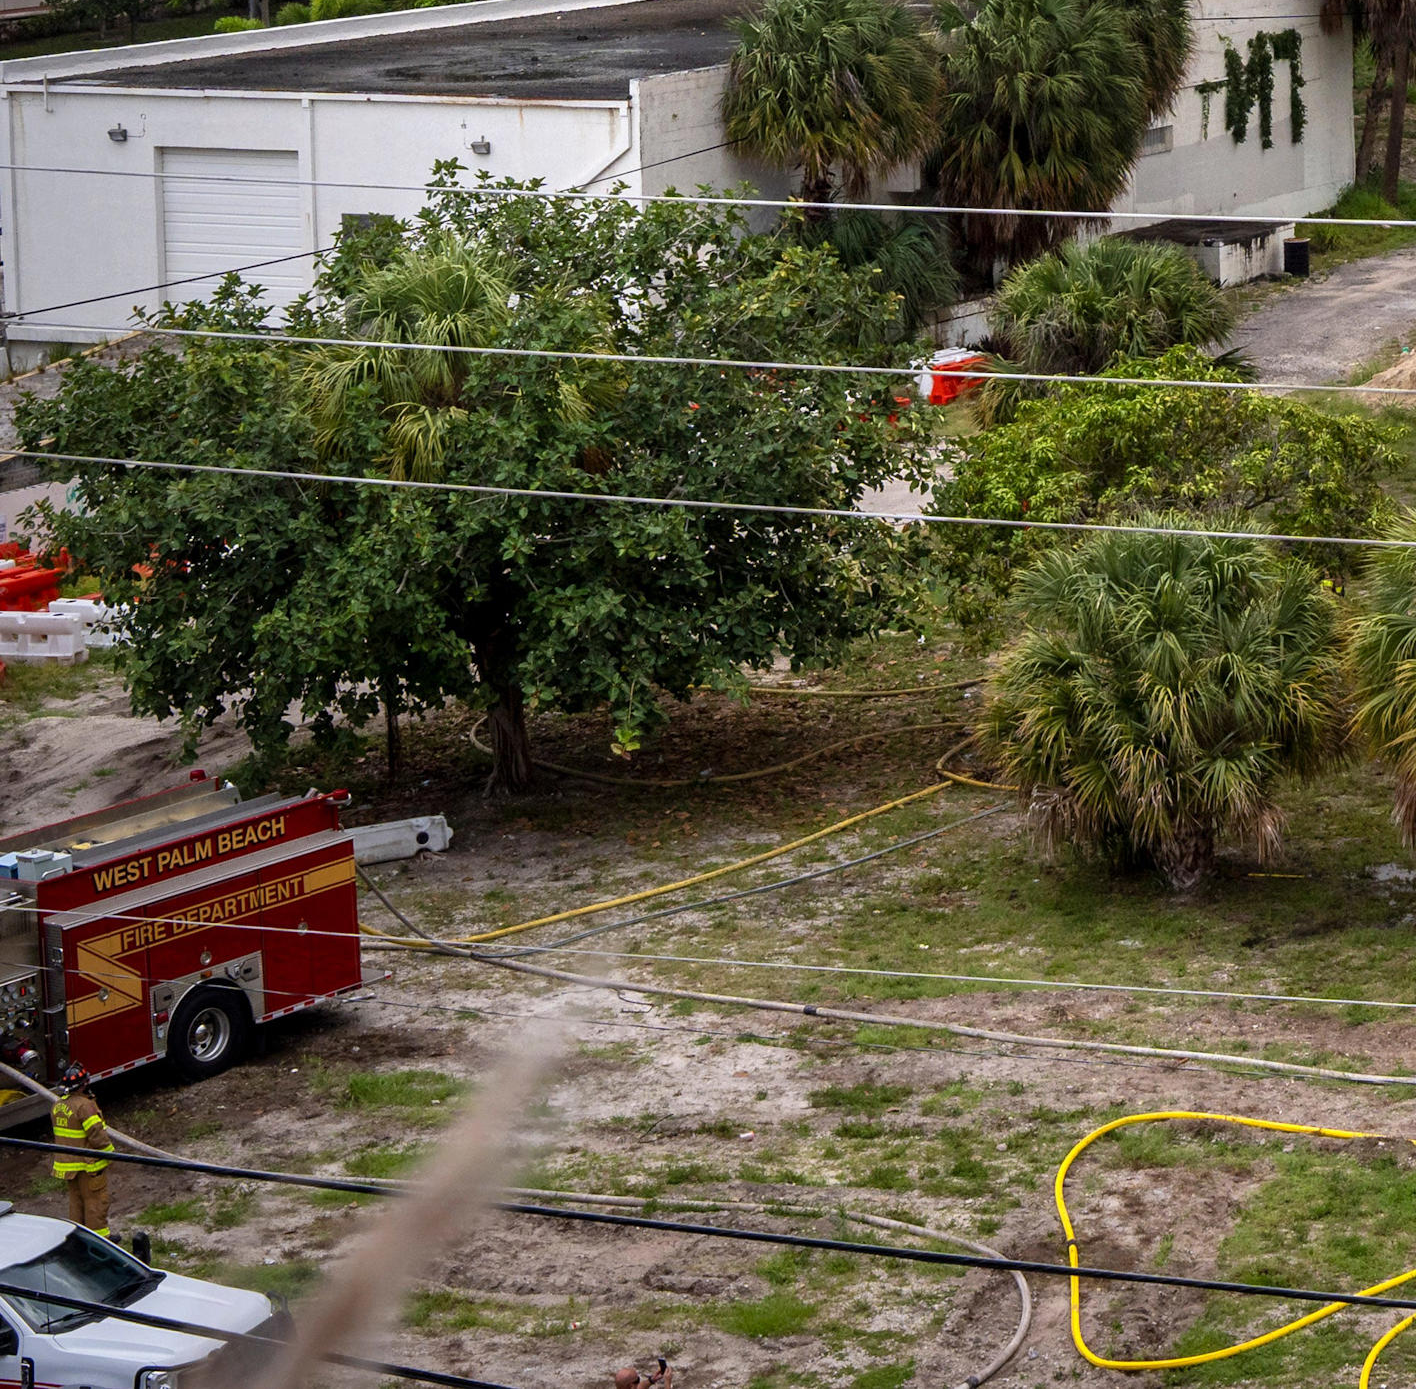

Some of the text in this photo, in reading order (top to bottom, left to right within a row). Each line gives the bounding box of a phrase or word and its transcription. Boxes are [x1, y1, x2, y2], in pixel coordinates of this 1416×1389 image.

[93, 815, 287, 892] WEST PALM BEACH
[122, 875, 304, 951] FIRE DEPARTMENT
